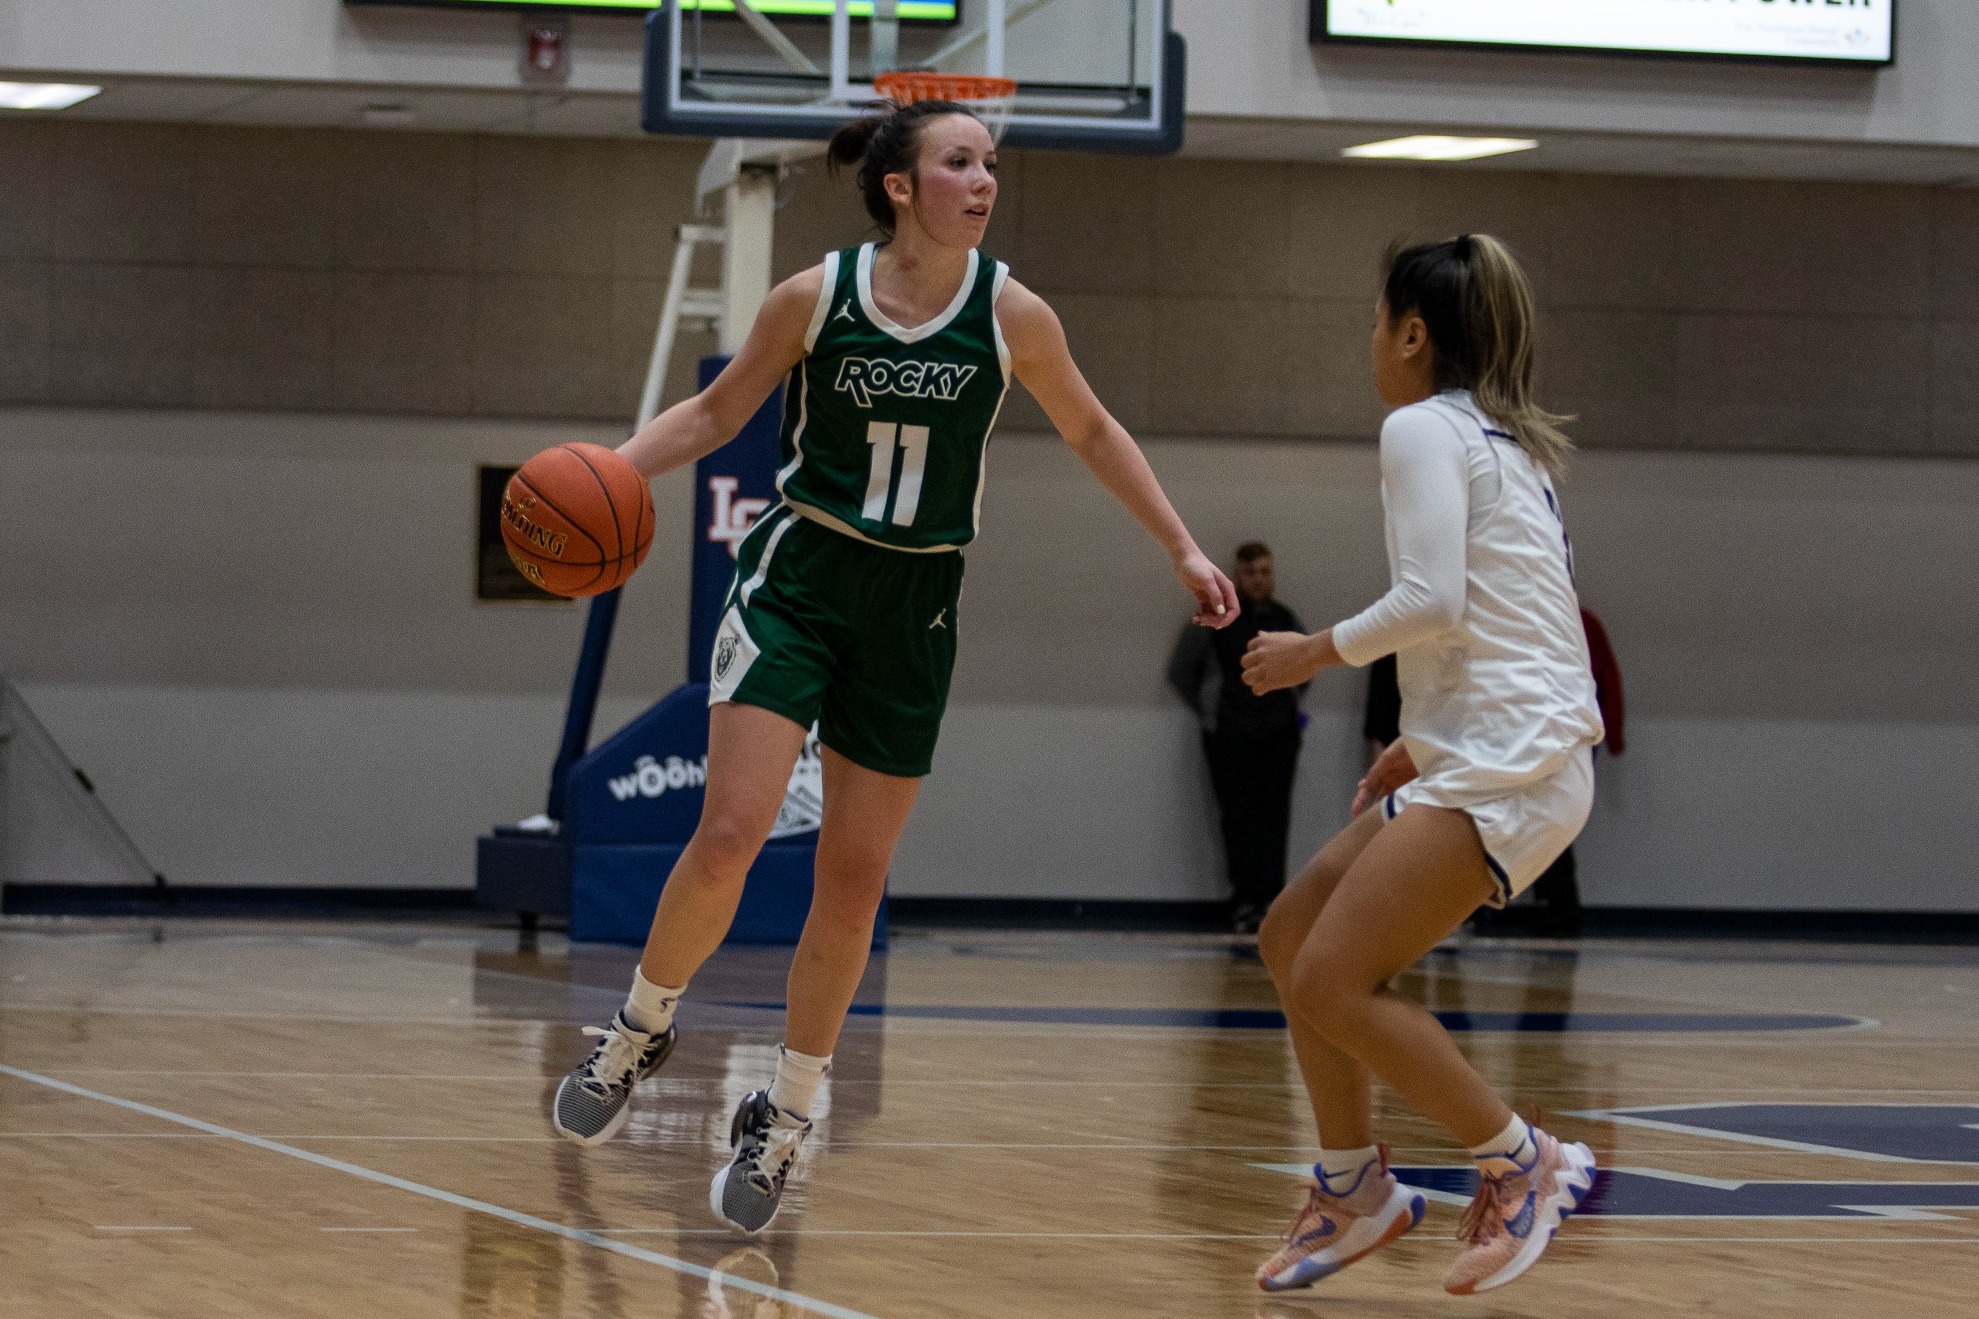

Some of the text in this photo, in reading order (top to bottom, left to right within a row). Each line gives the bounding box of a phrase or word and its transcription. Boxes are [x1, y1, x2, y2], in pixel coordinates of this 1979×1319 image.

[834, 356, 979, 409] ROCKY
[861, 420, 931, 528] 11
[501, 502, 568, 558] ALDING
